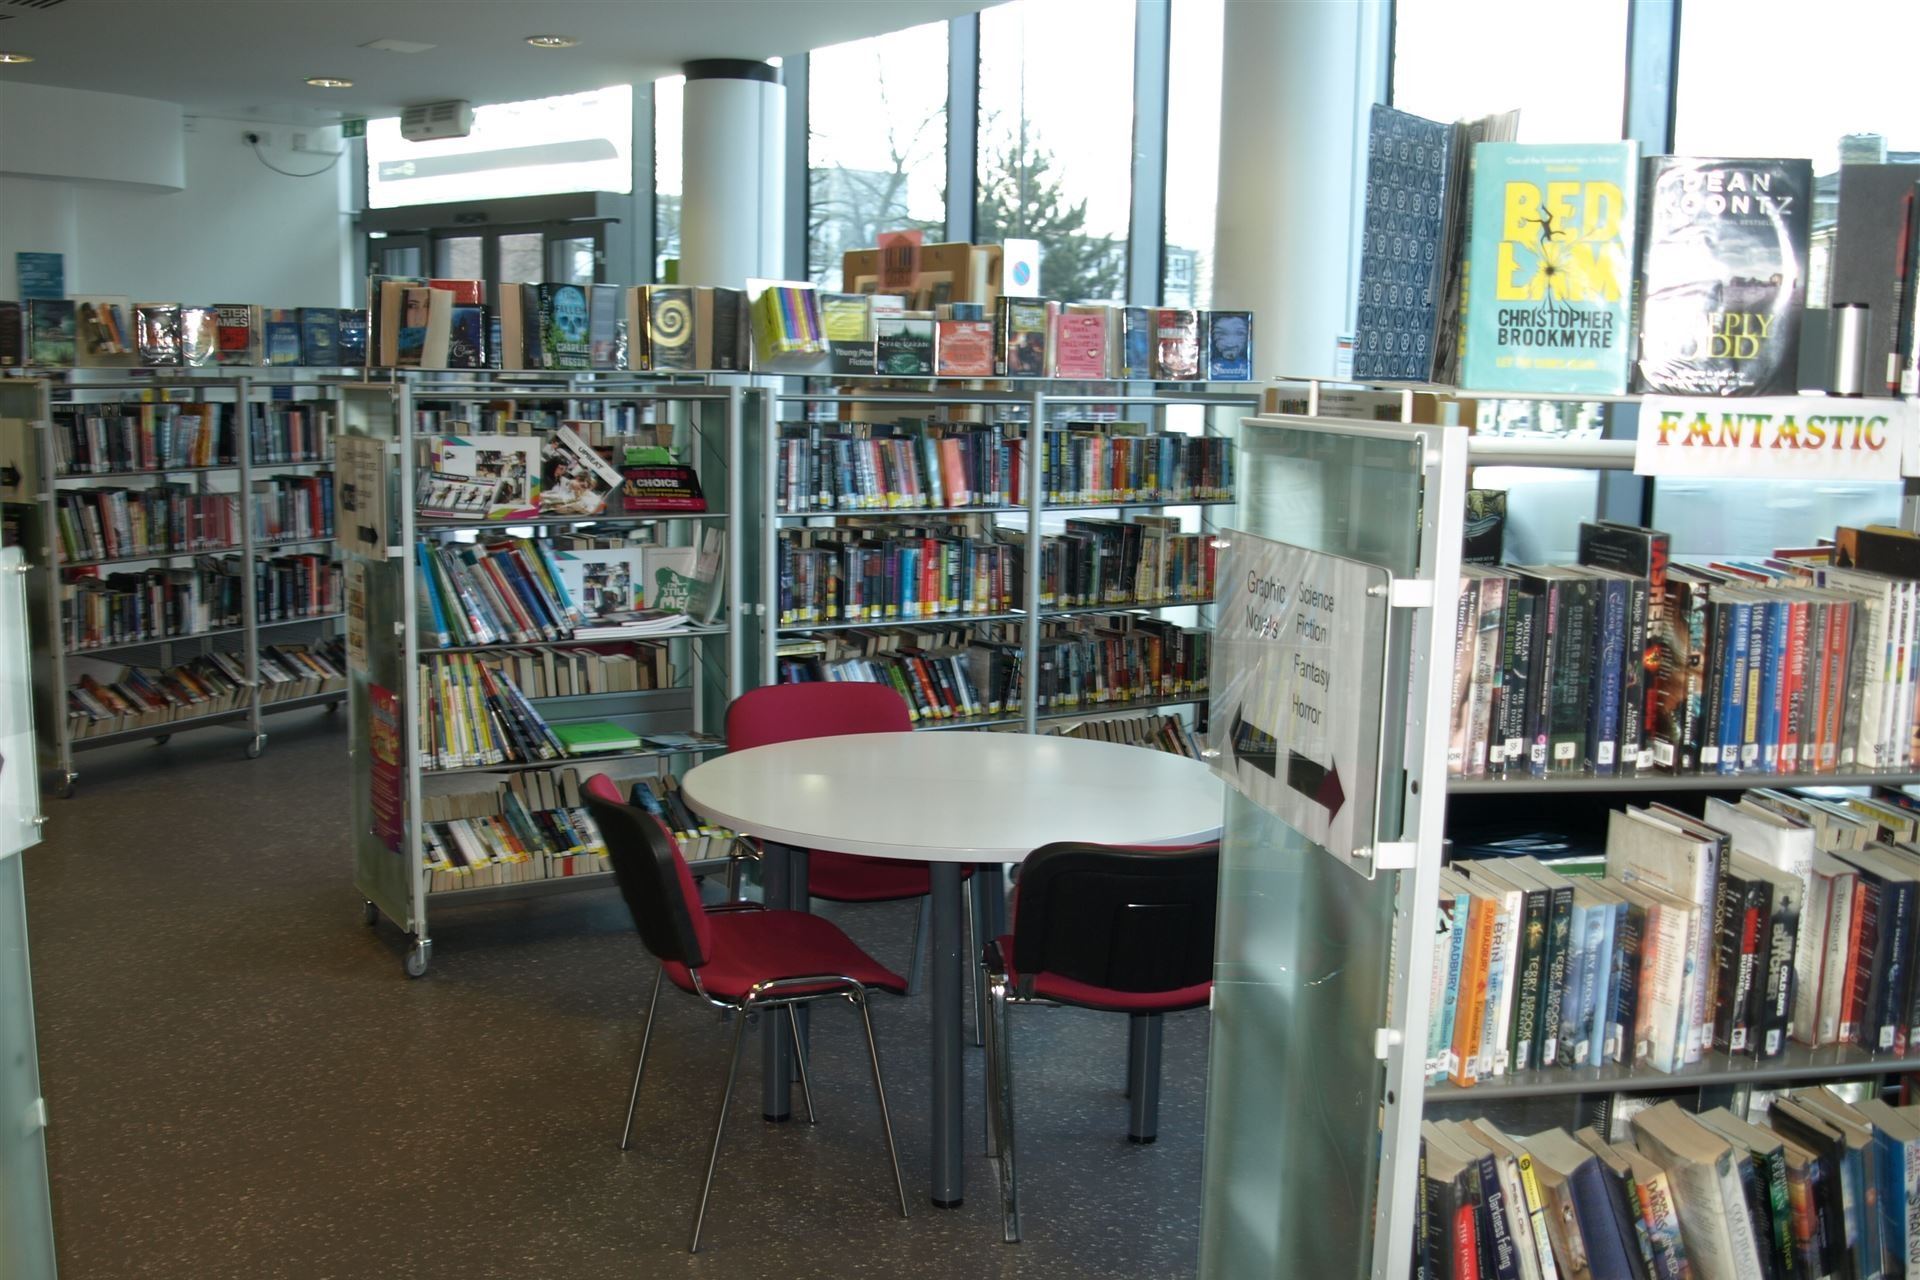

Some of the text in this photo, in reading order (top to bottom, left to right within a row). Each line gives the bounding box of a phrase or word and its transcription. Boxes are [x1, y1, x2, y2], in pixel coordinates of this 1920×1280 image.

[1683, 172, 1771, 192] DEAN
[1503, 181, 1625, 243] BED
[216, 318, 248, 327] AMES
[1498, 309, 1613, 329] CHRISTOPHER
[556, 343, 590, 352] CHARLIE
[835, 348, 857, 357] Young
[1498, 329, 1612, 348] BROOKMYRE
[849, 358, 874, 366] Fiction
[1657, 410, 1890, 452] FANTASTIC
[637, 479, 679, 487] CHOICE
[662, 588, 688, 597] STILL
[1247, 569, 1286, 604] Graphic
[1299, 582, 1335, 613] Science
[1647, 550, 1669, 640] ASHER
[1246, 606, 1279, 640] Novels
[1296, 613, 1327, 643] Fiction
[1457, 591, 1467, 638] Victorian
[1504, 589, 1518, 670] DOUGLAS ADAMS
[1633, 590, 1644, 652] Magic Bites
[1753, 606, 1763, 632] ISAAC
[1900, 613, 1908, 644] Ballard
[1454, 640, 1462, 670] Ghost
[1515, 621, 1524, 655] ADAMS
[1521, 614, 1532, 662] DOUGLAS
[1568, 605, 1584, 704] DOUGLAS ADAMS
[1715, 638, 1723, 669] ASIMOV
[1750, 634, 1762, 668] ASIMOV
[1294, 653, 1331, 690] Fantasy
[1788, 610, 1806, 734] ISAAC ASIMOV MAGIC
[1292, 694, 1322, 725] Horror
[1512, 694, 1518, 707] OF
[1515, 687, 1525, 738] THE SALMO
[1684, 675, 1695, 745] THE DEPARTURE
[1624, 702, 1633, 745] ANDREW
[1714, 882, 1728, 934] BROOKS
[1447, 928, 1463, 991] BRADBURY
[1491, 922, 1503, 963] BRIN
[1527, 955, 1539, 992] TERRY
[1737, 954, 1748, 1002] BURGESS
[1745, 954, 1753, 991] MELVIN
[1766, 923, 1785, 1001] BUTCHER
[1549, 949, 1564, 1039] TERRY BROOKS
[1583, 973, 1593, 1022] BROOKS
[1777, 966, 1788, 1017] COLD DAYS
[1485, 994, 1496, 1045] POSTMAN
[1469, 1043, 1477, 1056] 45
[1771, 1153, 1785, 1210] FEEHAN
[1488, 1192, 1512, 1270] Darkness Falling
